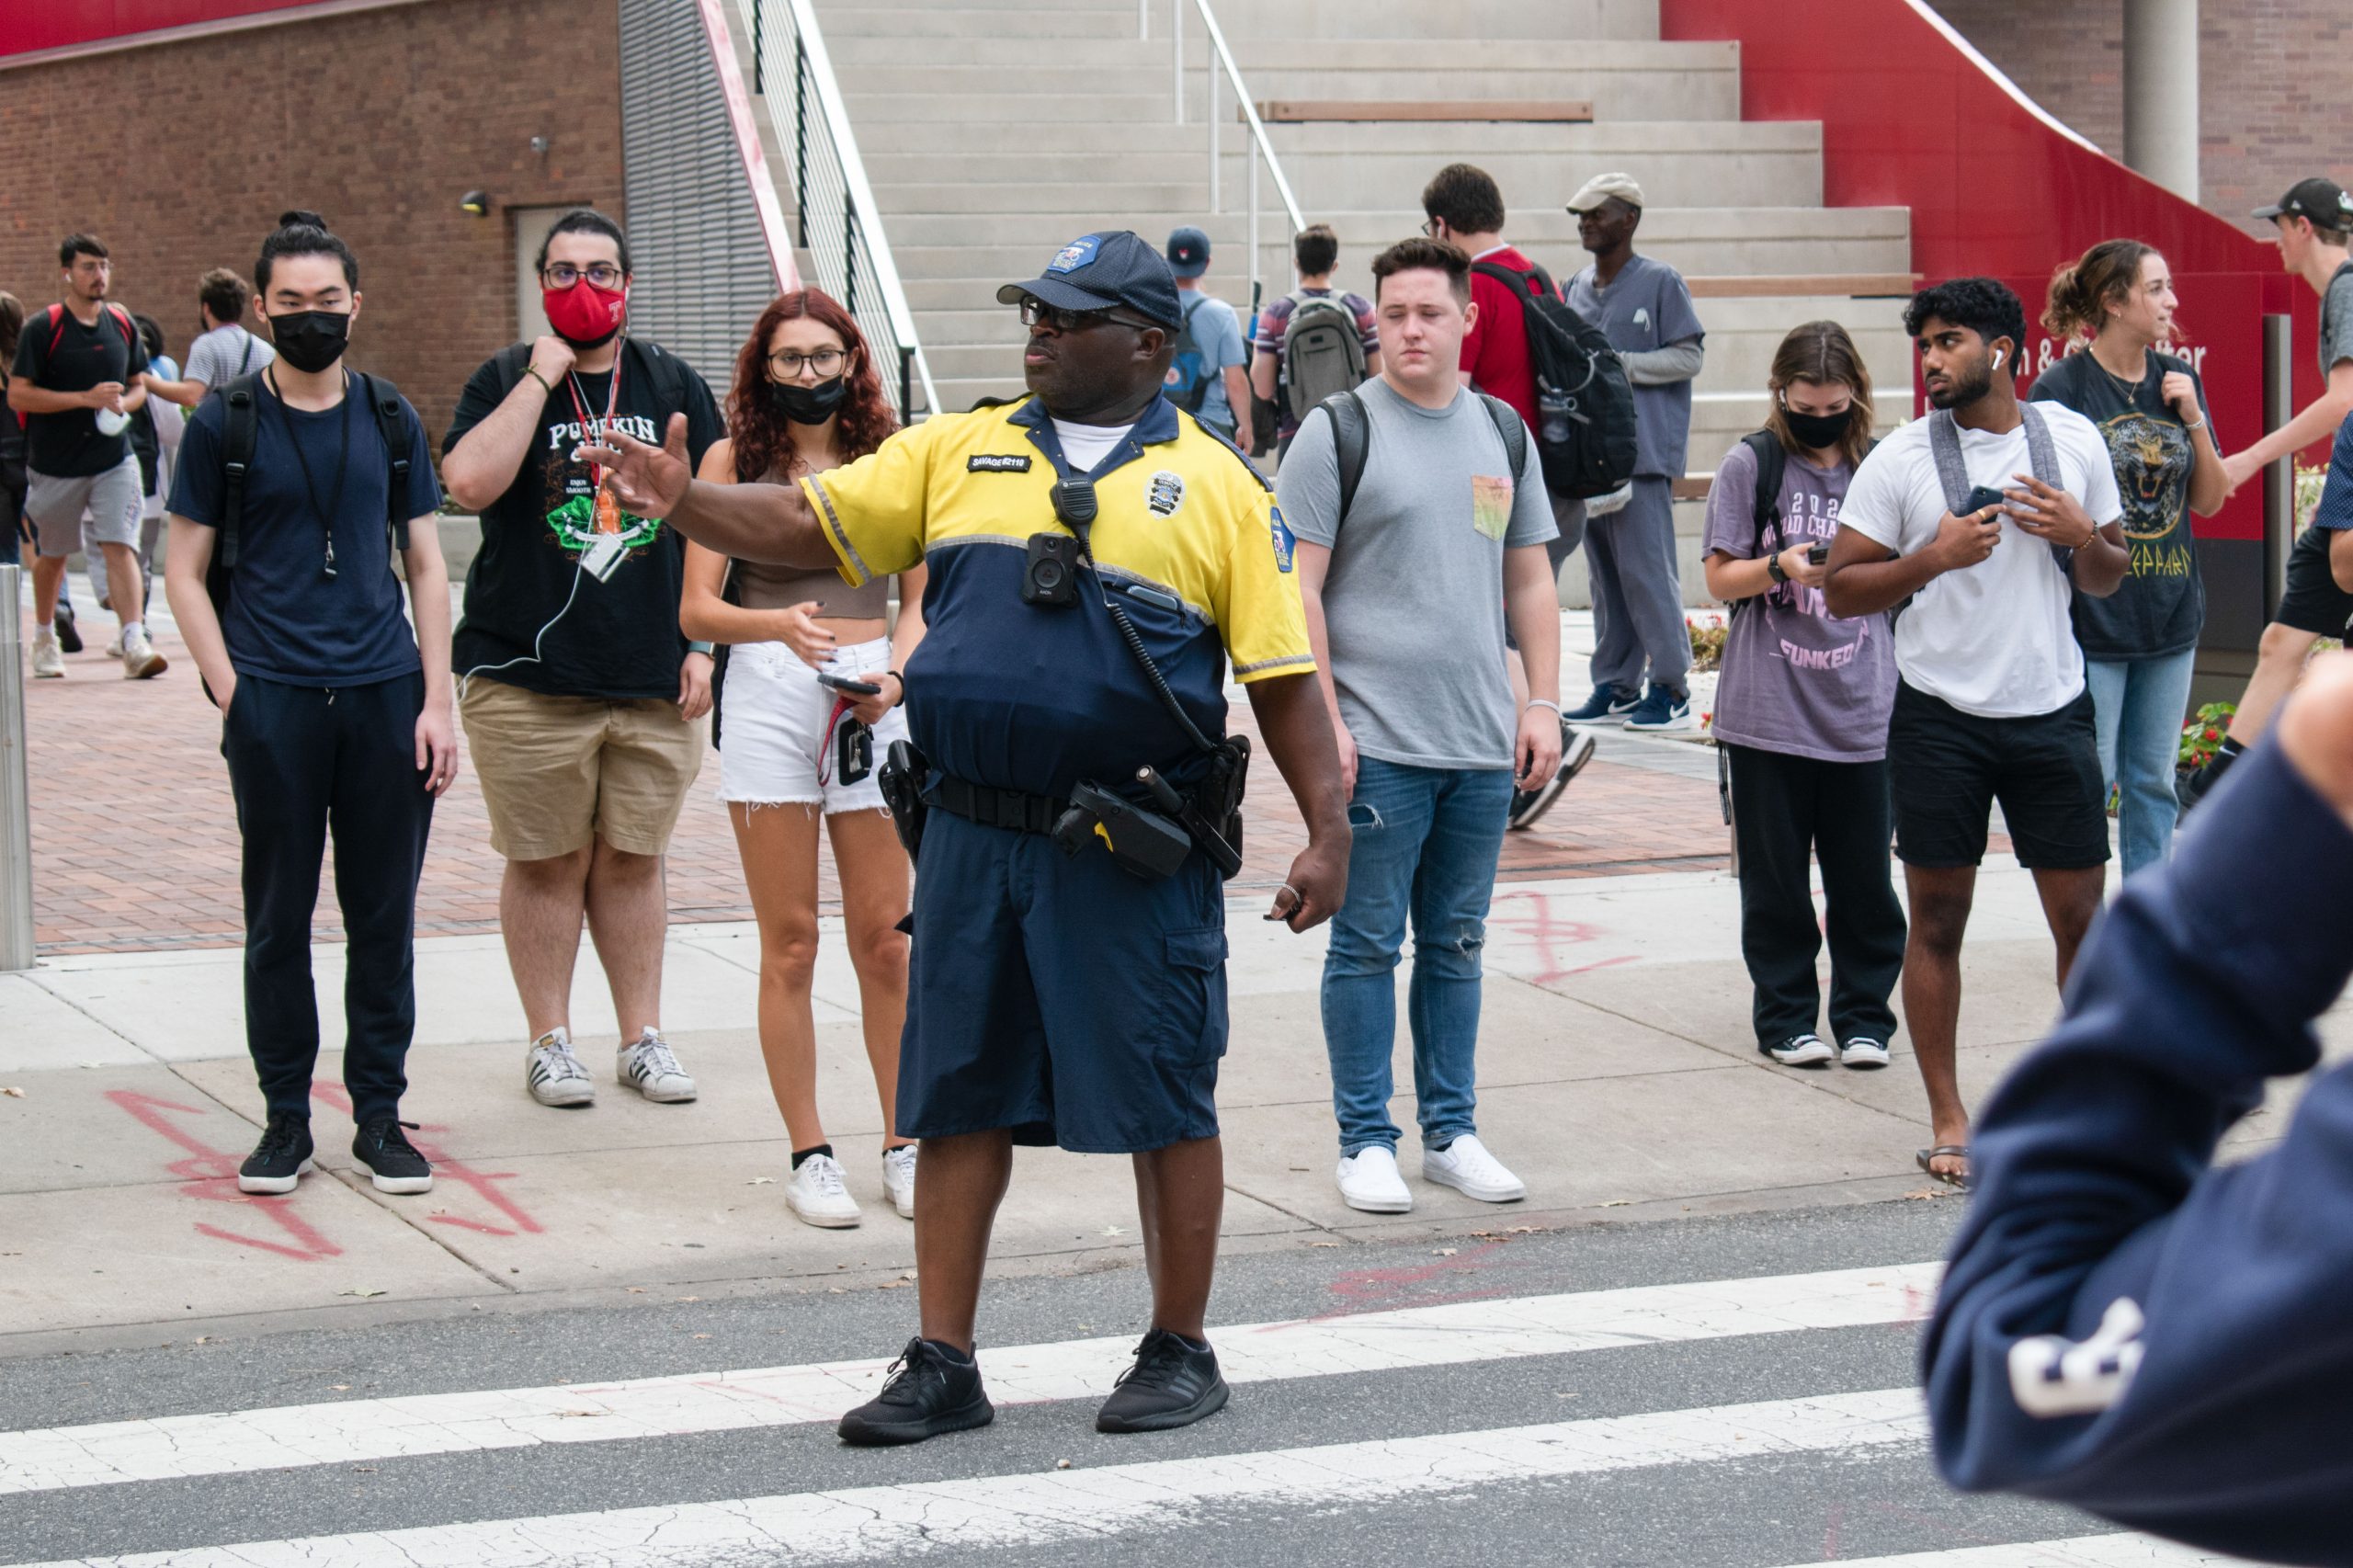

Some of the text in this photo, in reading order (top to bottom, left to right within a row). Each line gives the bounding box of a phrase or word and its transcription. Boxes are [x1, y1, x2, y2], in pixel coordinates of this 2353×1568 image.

[550, 415, 658, 449] PUMPKIN
[972, 457, 1002, 467] SAVAGE
[1791, 492, 1839, 520] 202
